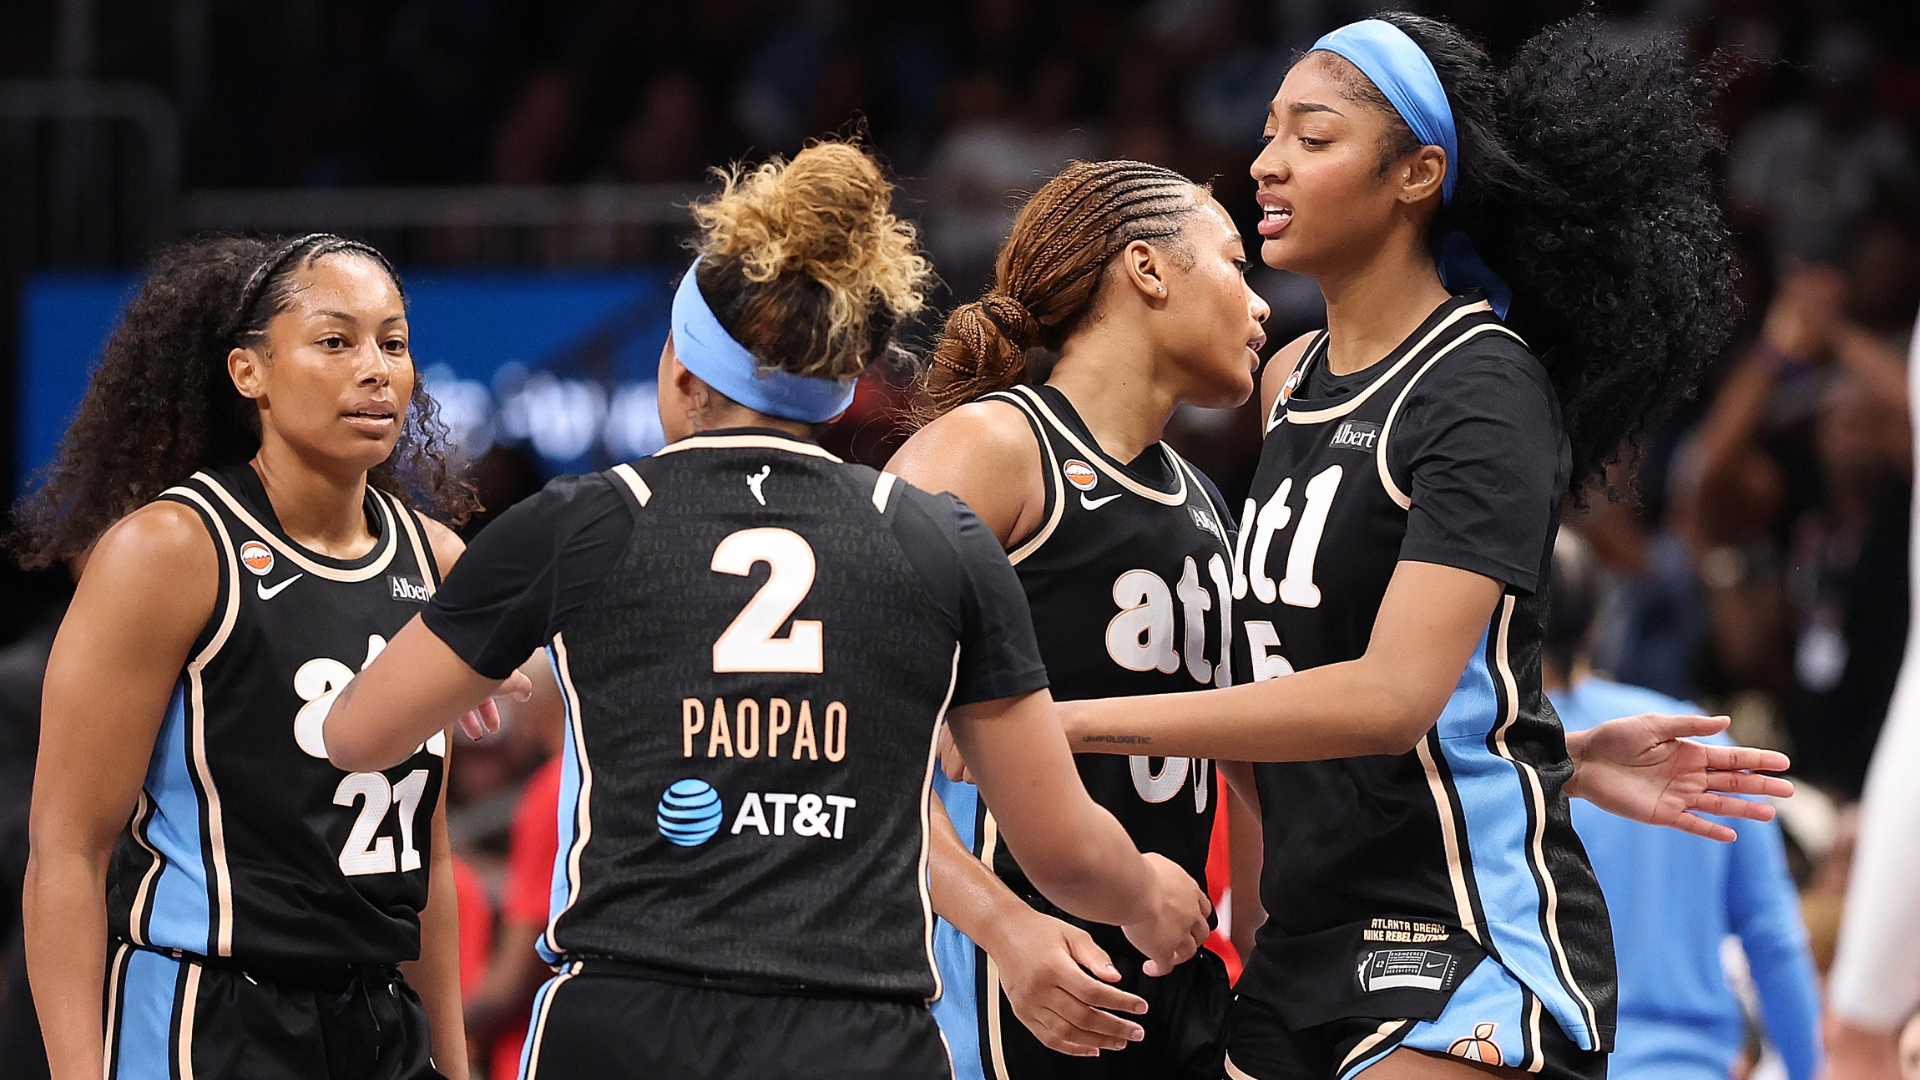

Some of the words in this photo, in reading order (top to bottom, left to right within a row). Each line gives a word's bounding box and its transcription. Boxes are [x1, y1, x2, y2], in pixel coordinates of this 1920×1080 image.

[1330, 423, 1377, 448] Albert
[710, 526, 825, 674] 2
[681, 697, 848, 763] PAOPAO
[332, 769, 430, 876] 21
[730, 792, 857, 840] AT&T
[1363, 929, 1385, 941] NIKE
[1385, 930, 1411, 942] REBEL
[1412, 933, 1450, 943] EDITION
[1371, 918, 1411, 931] ATLANTA
[1413, 922, 1446, 934] DREAM
